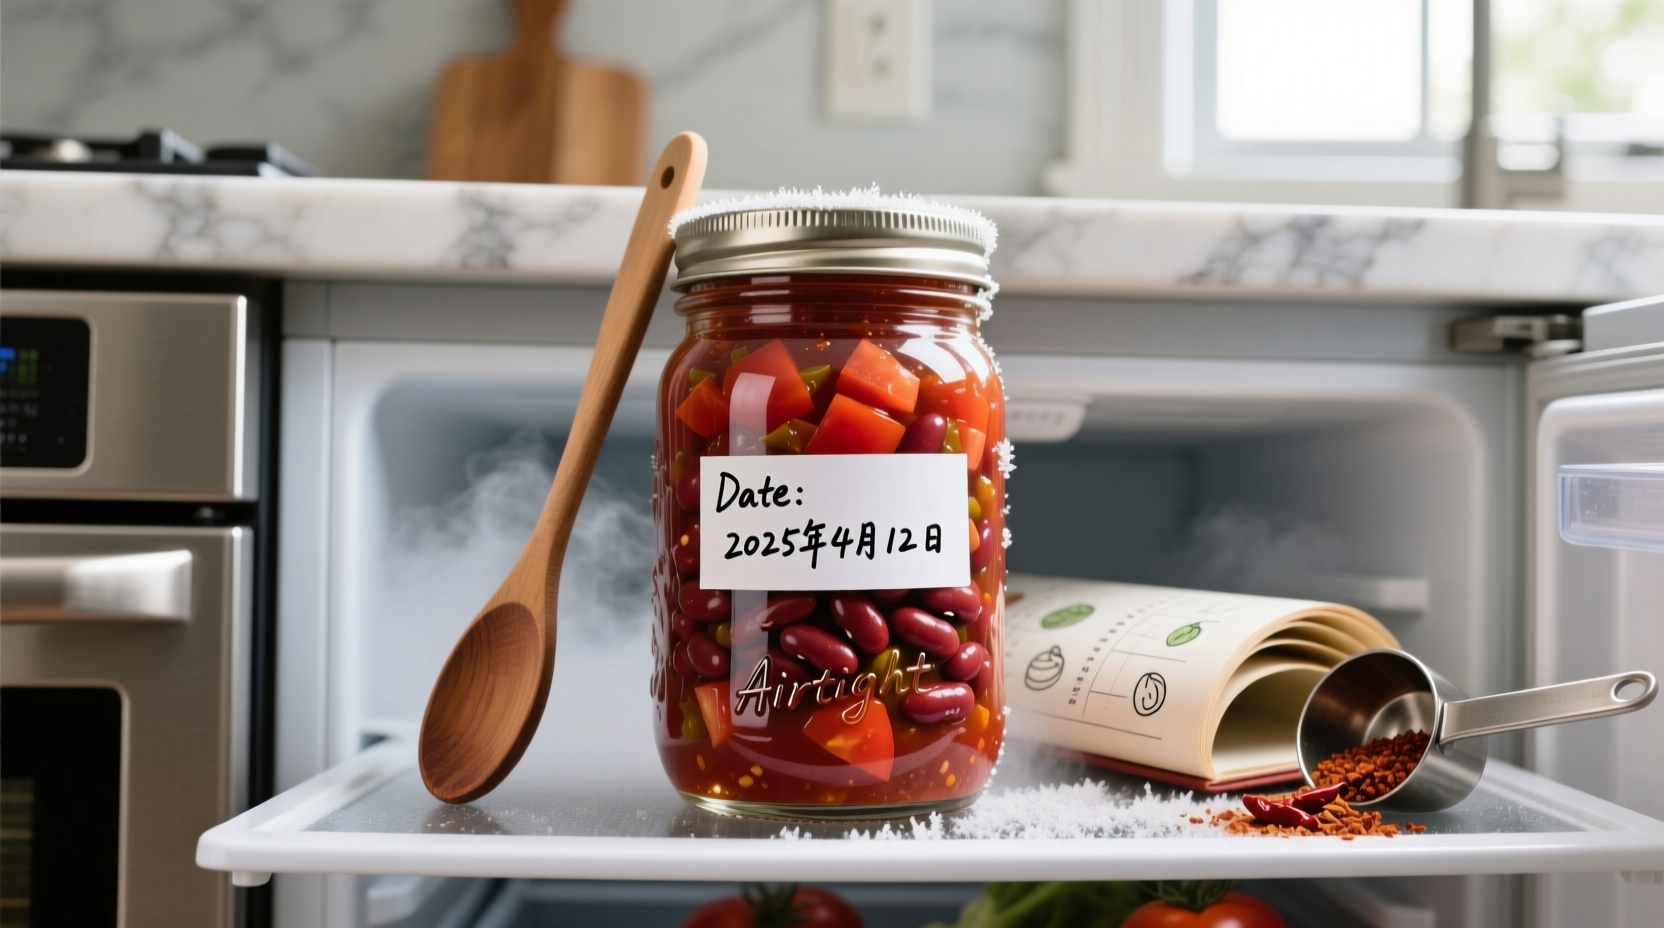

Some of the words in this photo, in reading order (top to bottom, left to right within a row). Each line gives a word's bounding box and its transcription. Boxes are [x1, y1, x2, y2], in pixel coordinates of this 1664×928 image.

[715, 471, 804, 514] Date:
[724, 518, 942, 570] 2025年4月12日
[735, 649, 936, 724] Airtight
